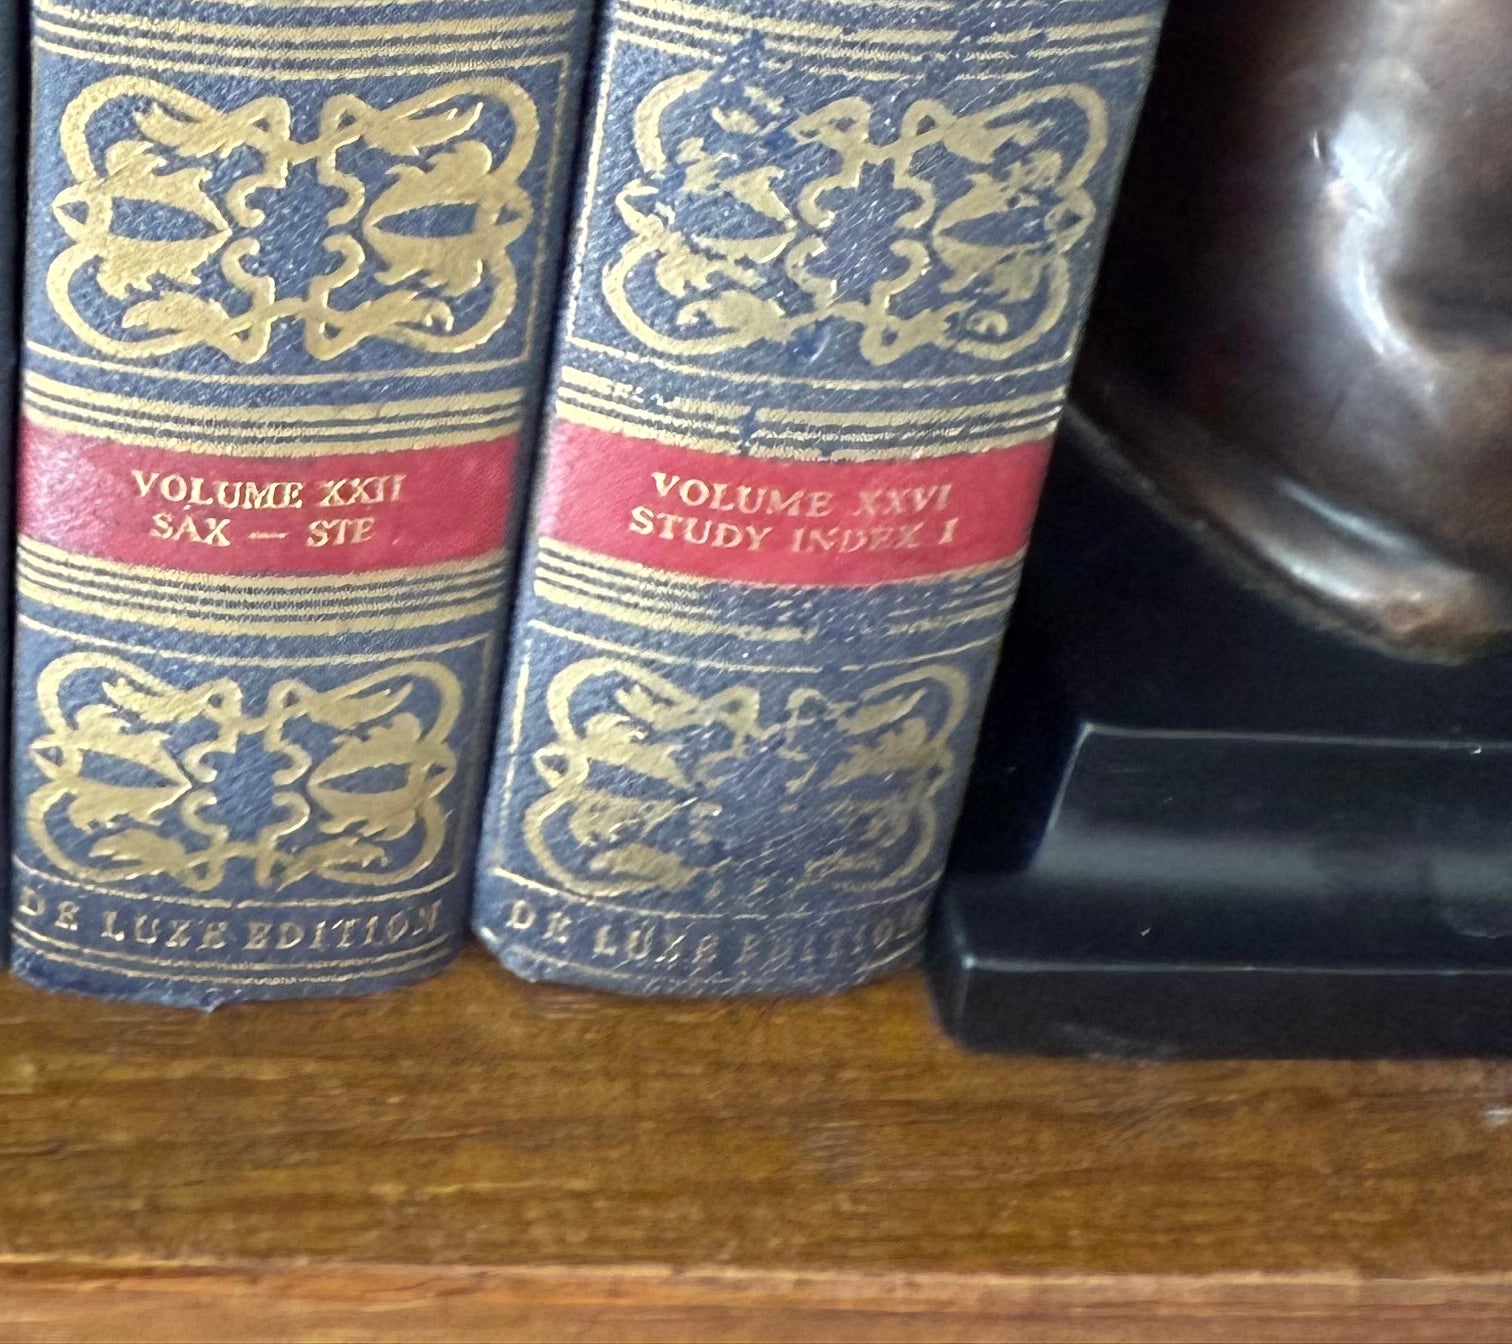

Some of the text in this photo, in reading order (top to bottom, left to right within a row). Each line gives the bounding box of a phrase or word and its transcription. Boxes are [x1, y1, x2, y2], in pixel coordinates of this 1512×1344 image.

[131, 470, 408, 510] VOLUME XXII
[651, 471, 953, 517] VOLUME XXVI
[150, 511, 232, 547] SAX
[306, 517, 377, 548] STE
[629, 505, 773, 552] STUDY
[791, 522, 925, 553] INDEX
[18, 886, 80, 932] DE
[242, 900, 444, 951] EDITION
[505, 899, 572, 944] DE
